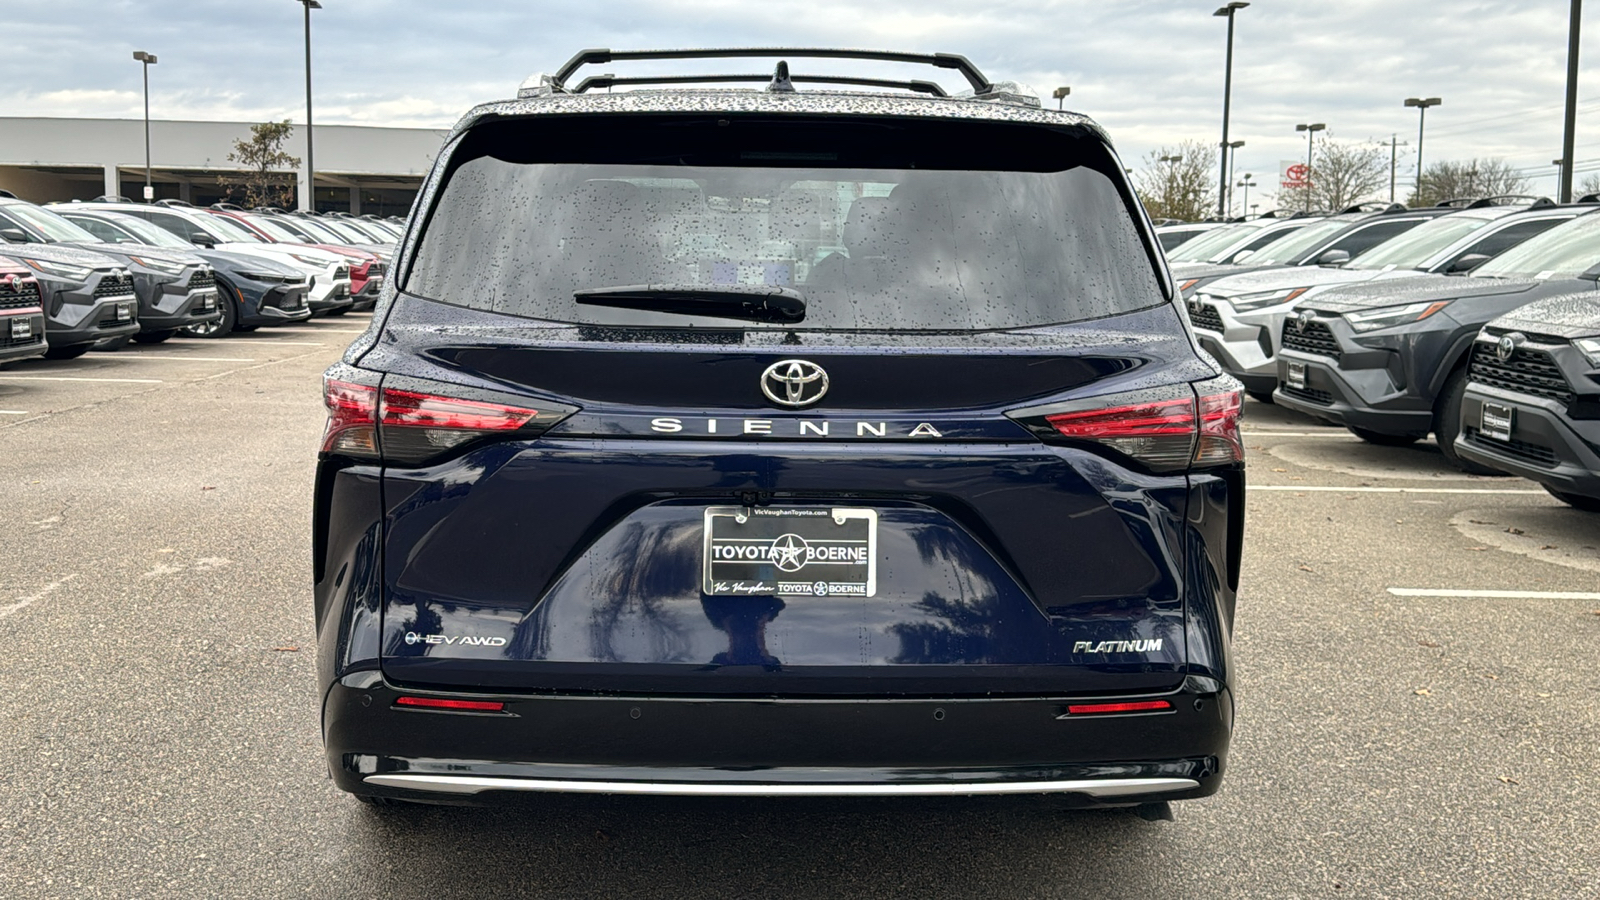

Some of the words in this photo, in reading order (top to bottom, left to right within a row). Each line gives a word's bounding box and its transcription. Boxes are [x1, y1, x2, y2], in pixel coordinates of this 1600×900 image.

[651, 417, 943, 437] SIENNA
[754, 509, 828, 517] VicVaughanToyota.com
[712, 545, 779, 560] TOYOTA
[806, 546, 868, 560] BOERNE
[714, 581, 729, 592] Vic
[732, 581, 775, 594] Vaughan
[778, 585, 813, 593] TOYOTA
[828, 585, 866, 593] BOERNE
[459, 636, 507, 646] AWD
[1073, 638, 1163, 653] PLATINUM
